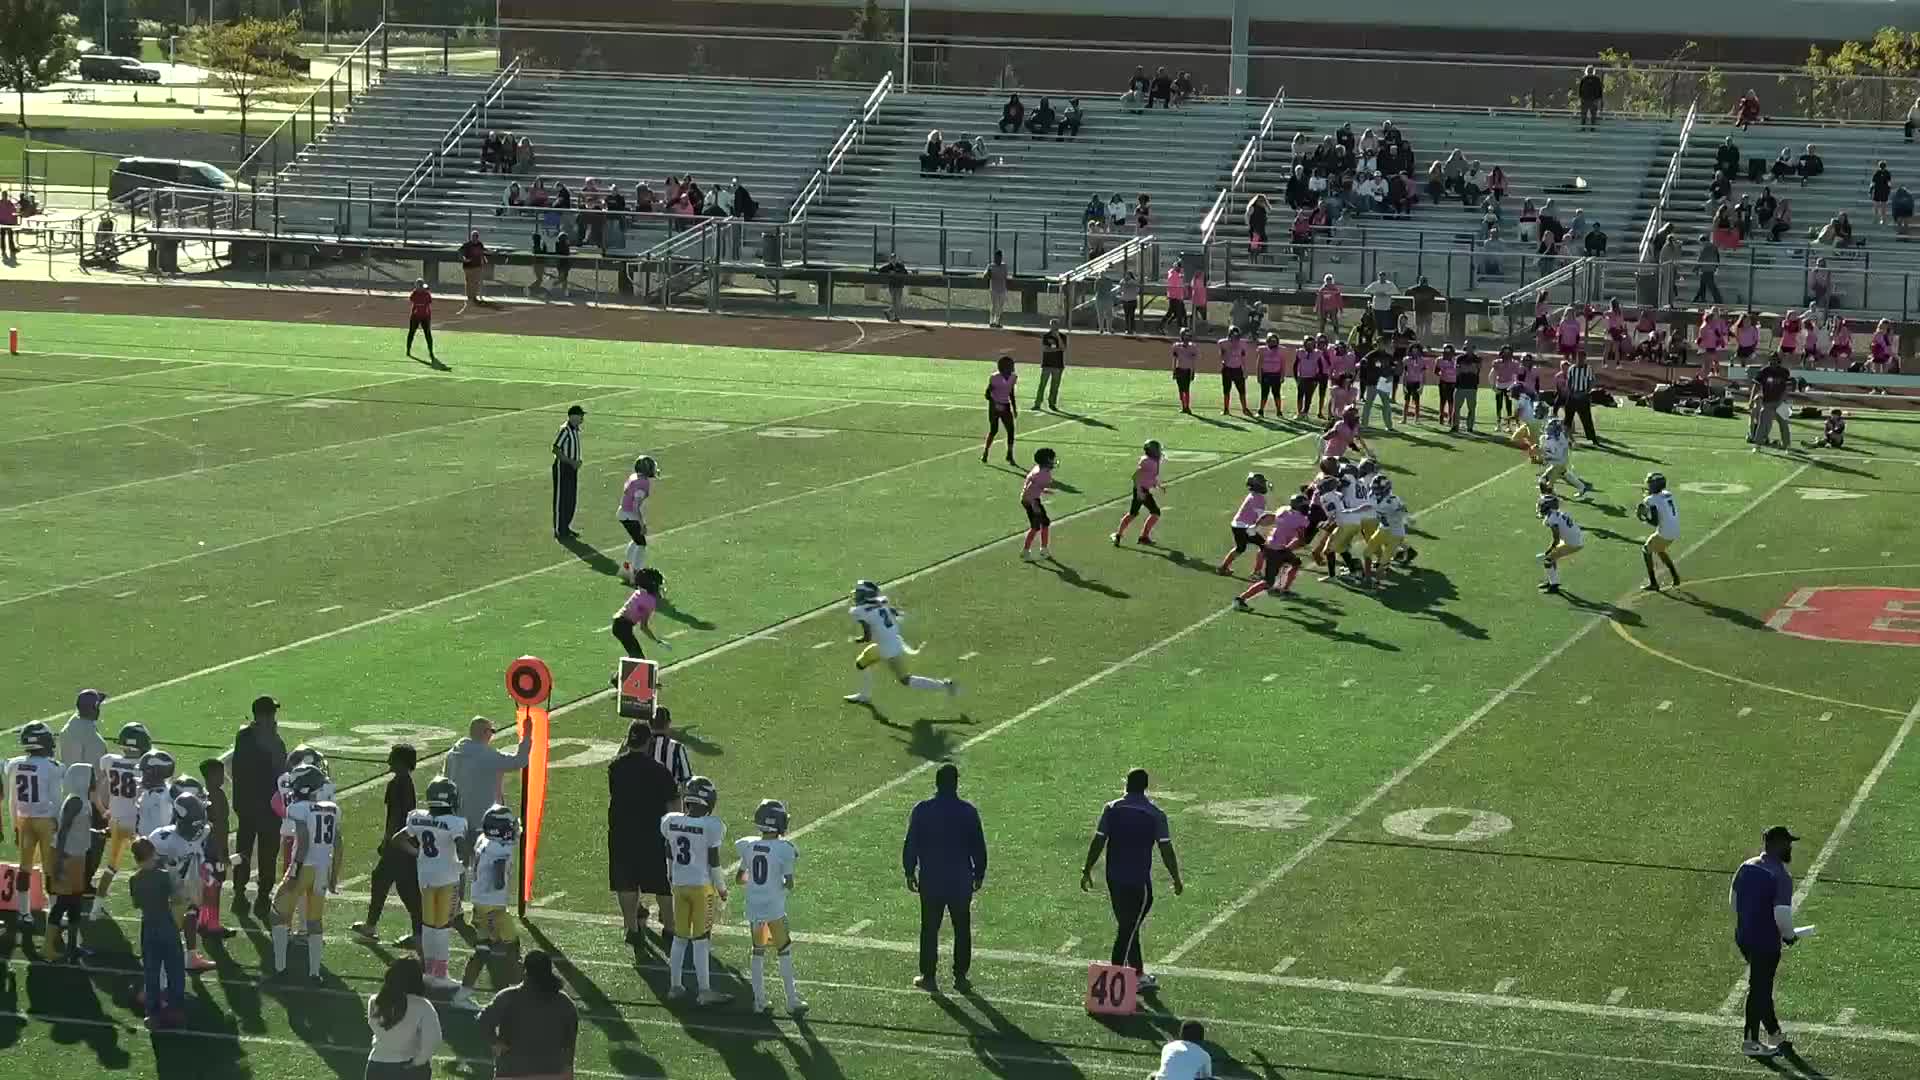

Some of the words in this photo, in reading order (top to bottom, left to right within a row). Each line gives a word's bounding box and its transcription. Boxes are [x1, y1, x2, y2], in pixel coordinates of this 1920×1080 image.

[622, 662, 655, 702] 4
[15, 775, 40, 803] 21
[109, 770, 137, 799] 28
[314, 814, 336, 845] 13
[421, 829, 439, 858] 8
[676, 835, 692, 866] 3
[752, 854, 769, 886] 0
[1091, 970, 1126, 1007] 40
